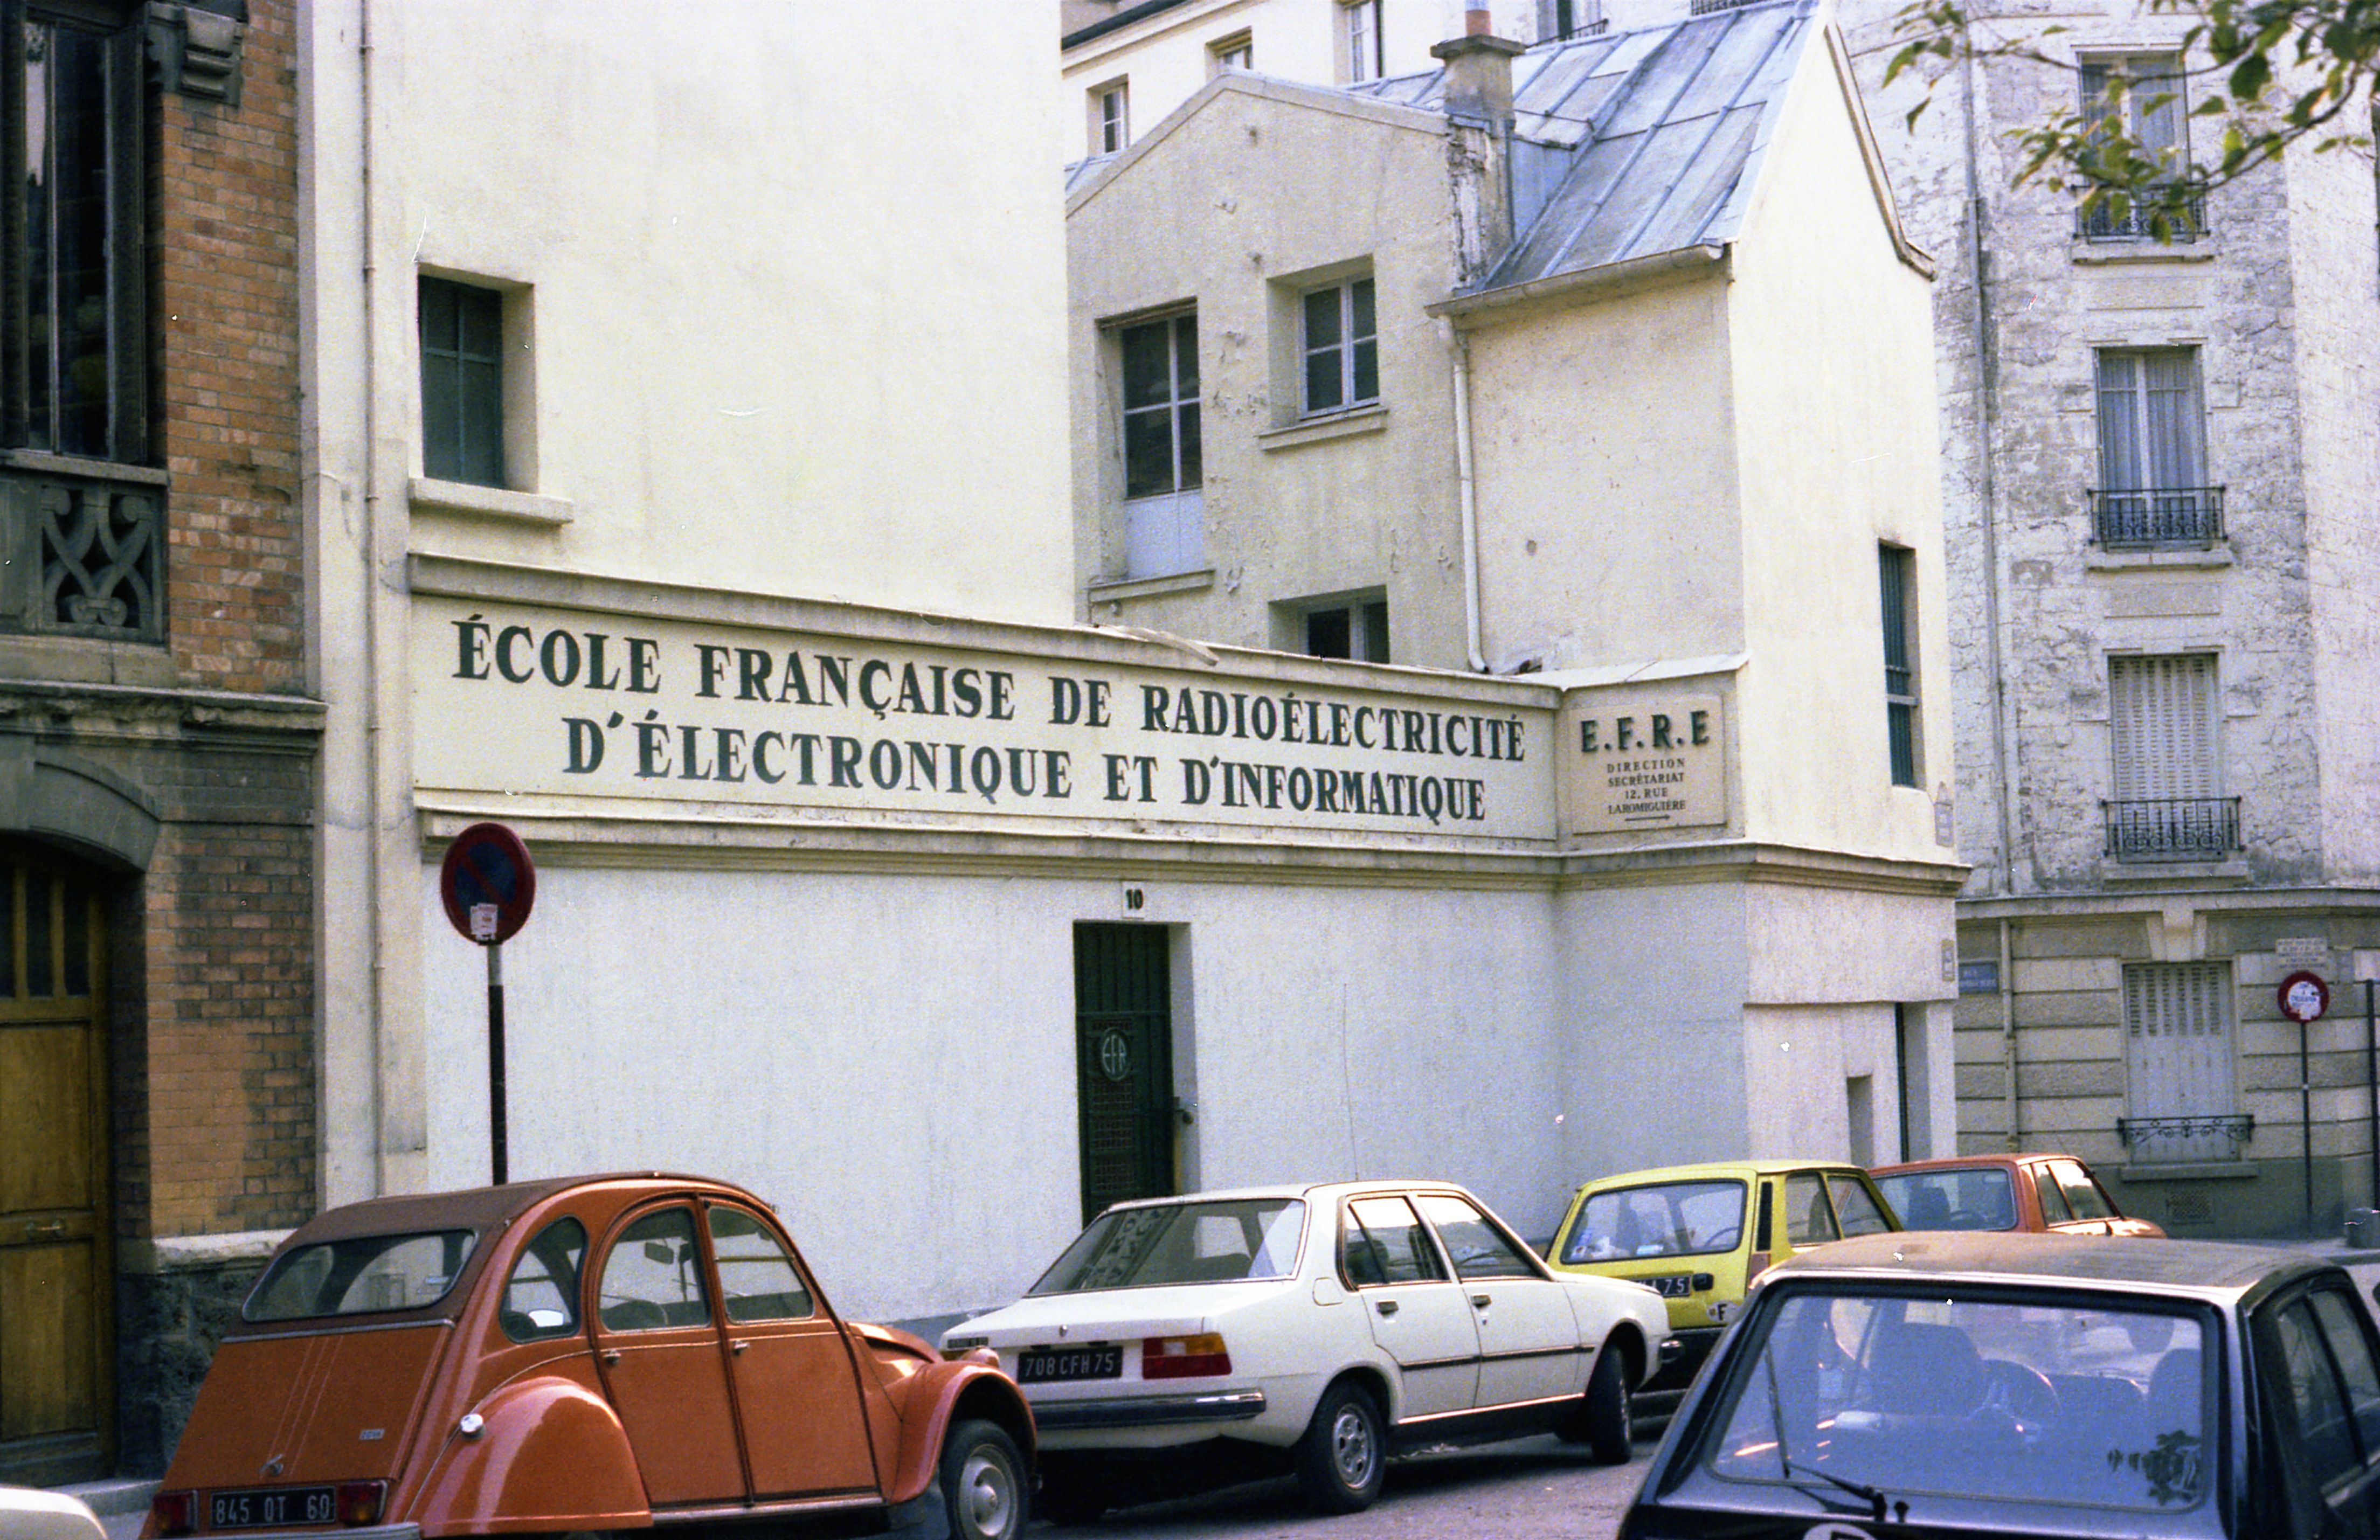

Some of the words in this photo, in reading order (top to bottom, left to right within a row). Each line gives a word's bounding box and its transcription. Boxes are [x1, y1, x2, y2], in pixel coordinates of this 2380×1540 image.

[451, 613, 661, 694] ÉCOLE
[694, 643, 1015, 720] FRANÇAISE
[1048, 676, 1111, 728] DE
[1140, 684, 1525, 762] RADIOÉLECTRICITÉ
[562, 709, 1071, 804] D'ÉLECTRONIQUE
[1103, 754, 1158, 803] ET
[1180, 755, 1485, 827] D'INFORMATIQUE
[1607, 758, 1685, 774] DIRECTION
[1608, 772, 1685, 788] SECRÉTARIAT
[1644, 787, 1668, 799] RUE
[1125, 889, 1144, 910] 10
[1717, 1303, 1727, 1321] F
[1025, 1357, 1056, 1377] 708
[1059, 1355, 1090, 1375] CFH
[1095, 1352, 1115, 1373] 75
[216, 1498, 250, 1524] 845
[307, 1494, 330, 1520] 60
